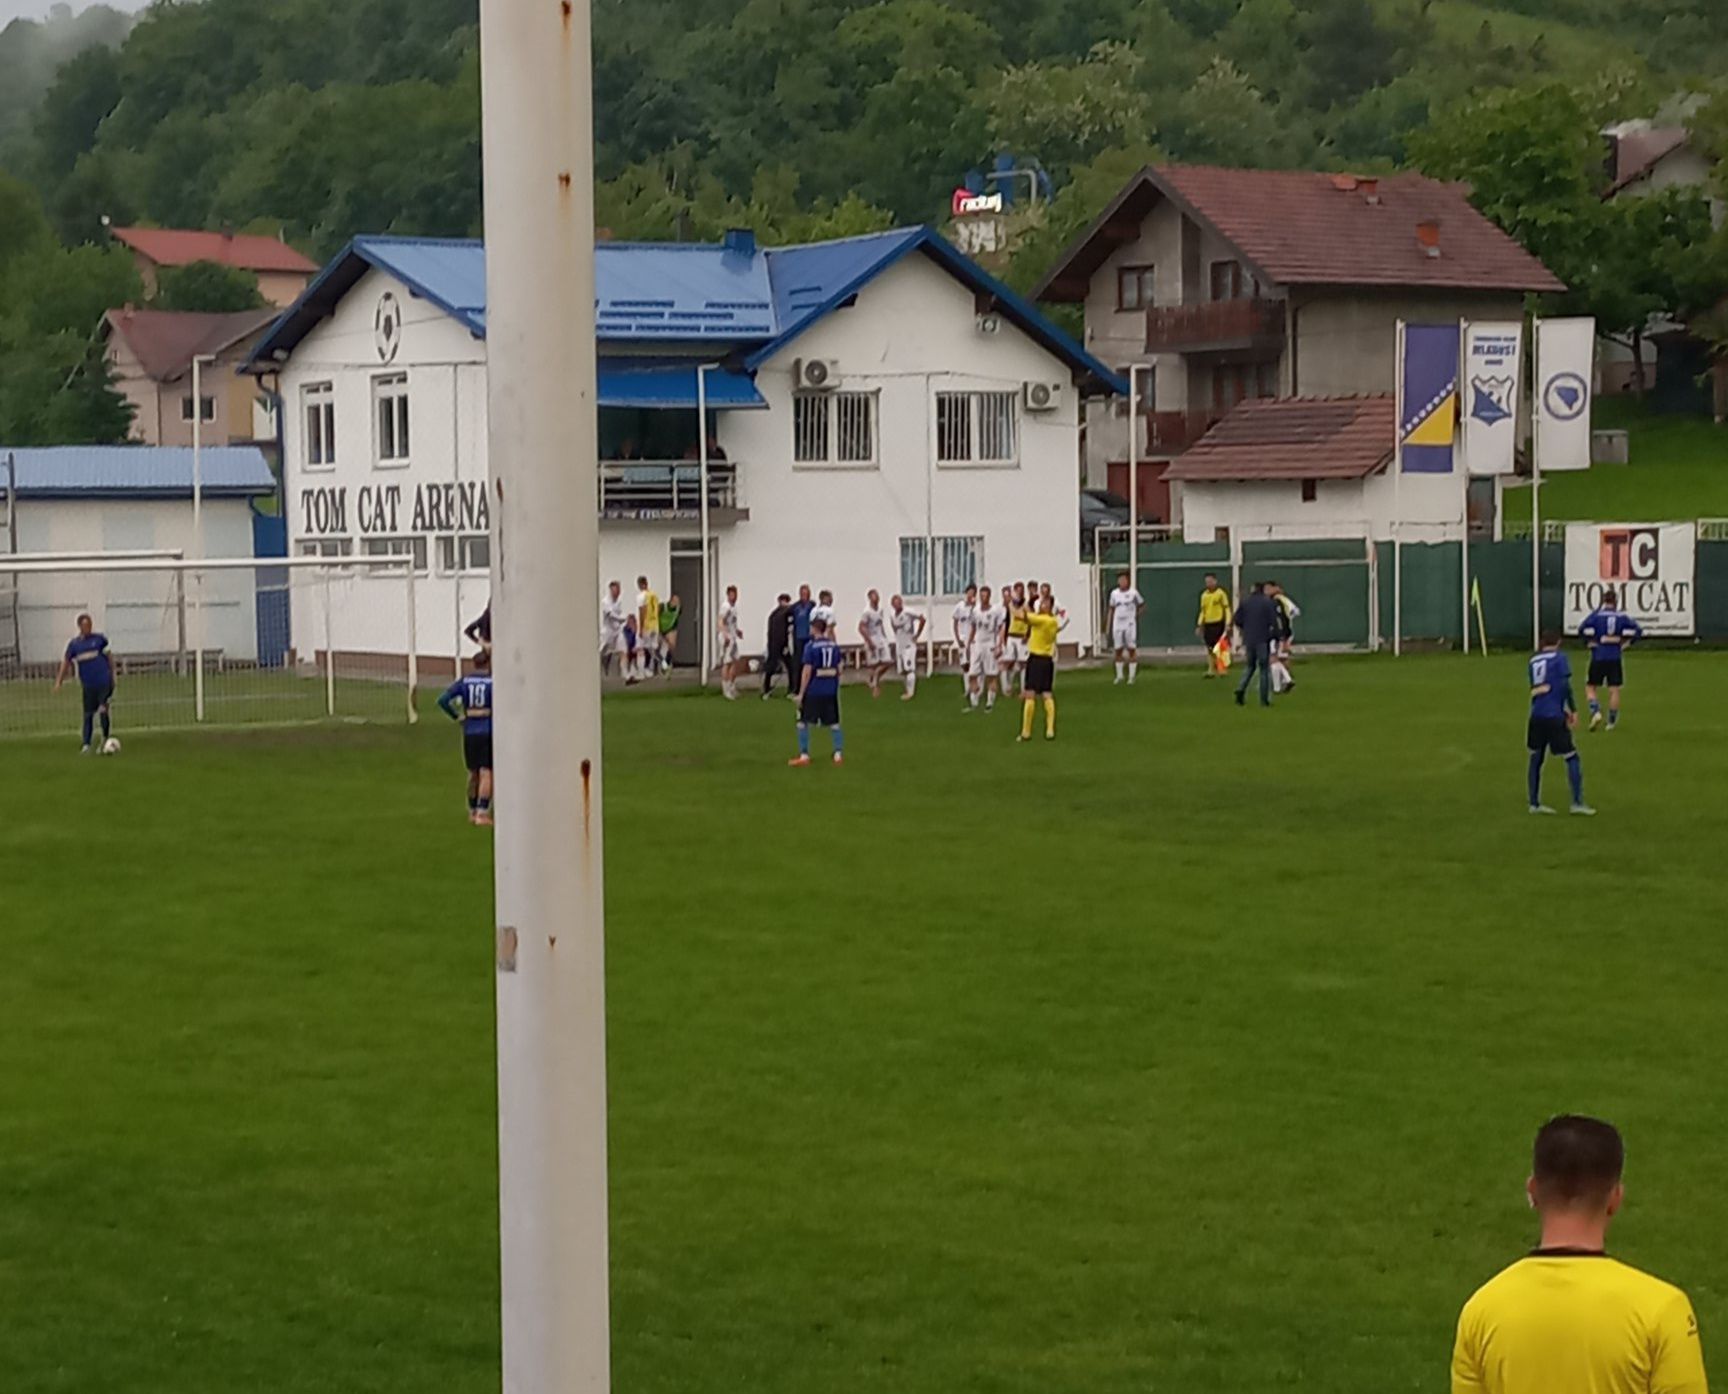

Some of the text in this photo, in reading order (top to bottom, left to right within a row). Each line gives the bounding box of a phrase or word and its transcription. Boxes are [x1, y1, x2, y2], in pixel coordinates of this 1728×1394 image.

[301, 481, 490, 533] TOM CAT ARENA
[1603, 532, 1656, 578] TC
[1637, 581, 1689, 612] CAT
